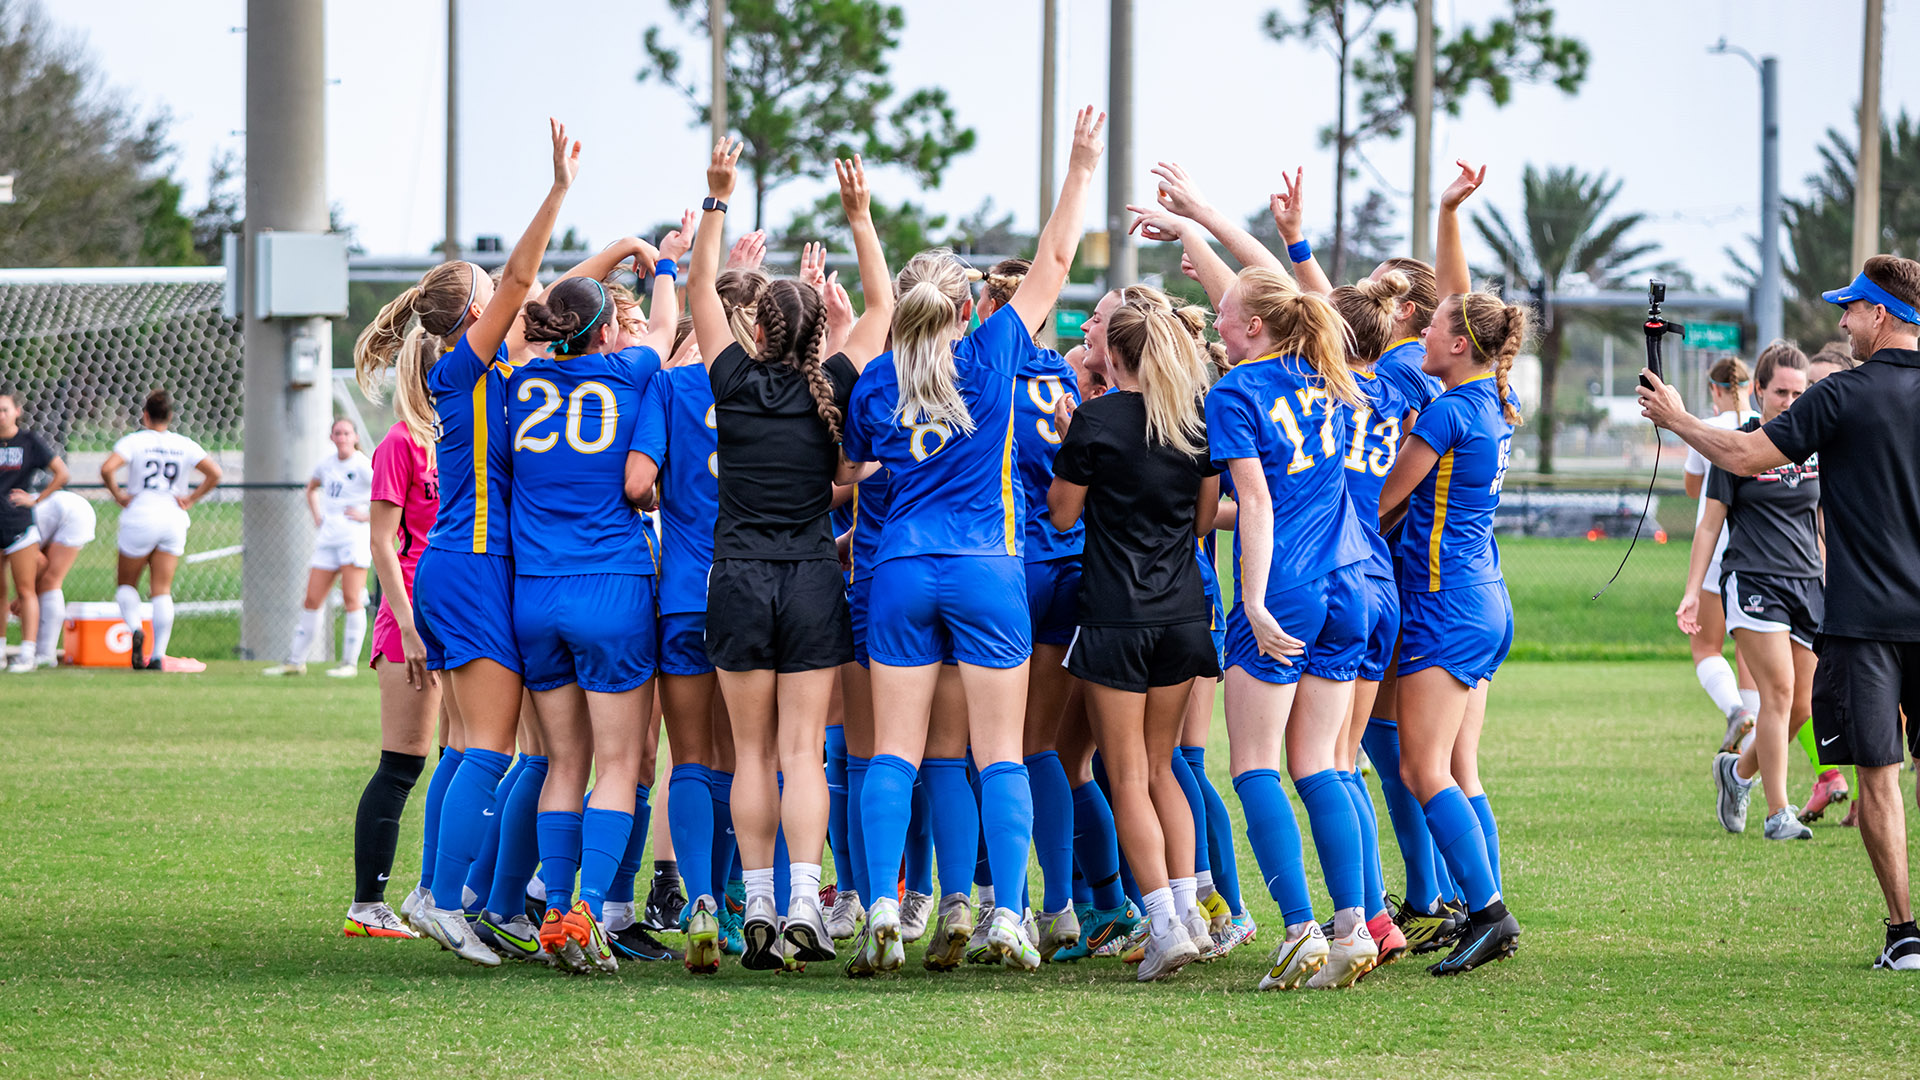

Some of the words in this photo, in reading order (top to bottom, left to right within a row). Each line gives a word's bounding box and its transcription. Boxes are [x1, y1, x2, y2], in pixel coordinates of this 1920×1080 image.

[514, 377, 620, 455] 20
[1027, 375, 1064, 444] 9
[1269, 386, 1336, 475] 17
[1344, 406, 1401, 477] 13
[144, 460, 178, 490] 29
